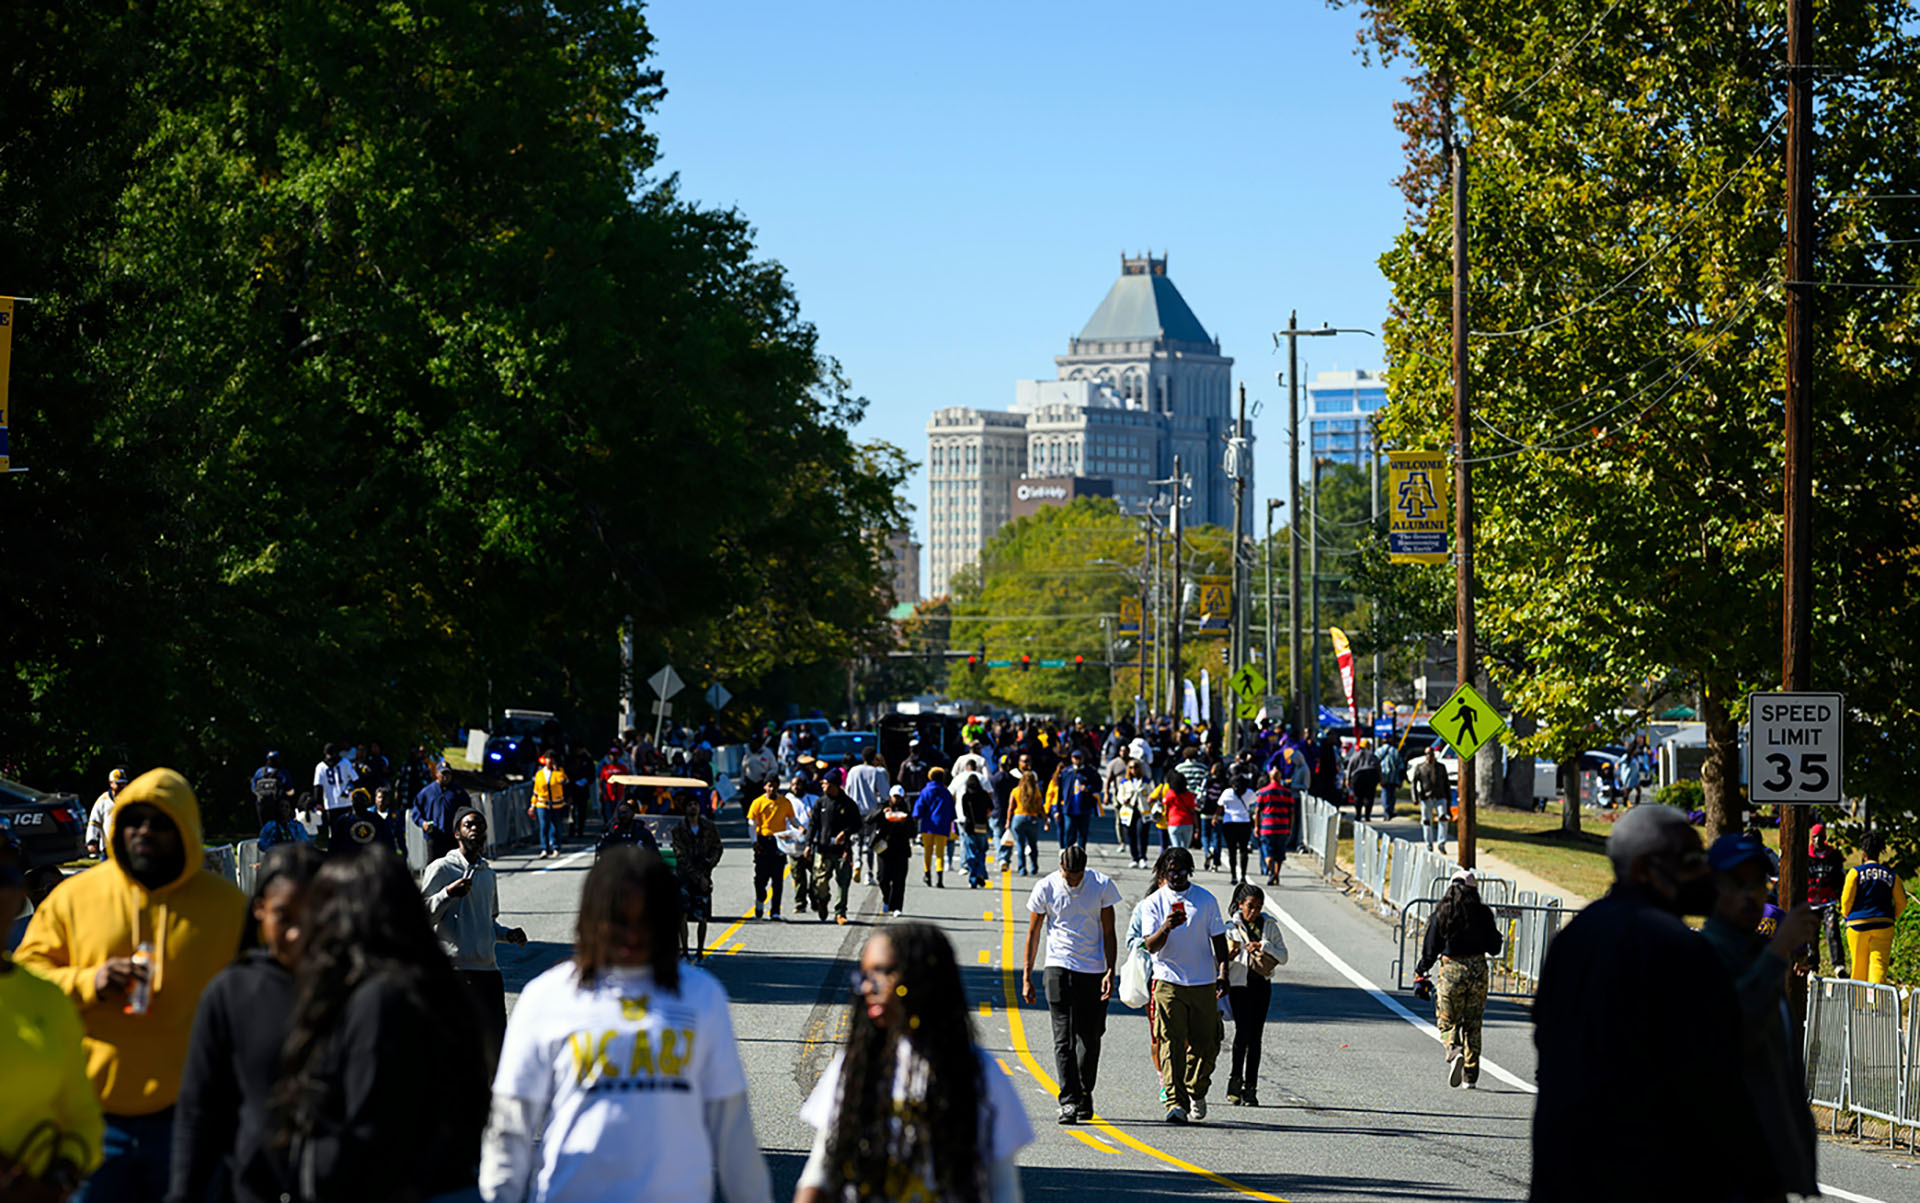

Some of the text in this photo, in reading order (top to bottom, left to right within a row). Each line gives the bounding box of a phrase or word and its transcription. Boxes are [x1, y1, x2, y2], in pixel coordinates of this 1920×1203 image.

[1390, 460, 1444, 470] WELCOME
[1392, 520, 1445, 530] ALUMNI
[1761, 704, 1831, 722] SPEED
[1768, 728, 1822, 745] LIMIT
[1762, 753, 1830, 793] 35
[14, 813, 44, 825] ICE
